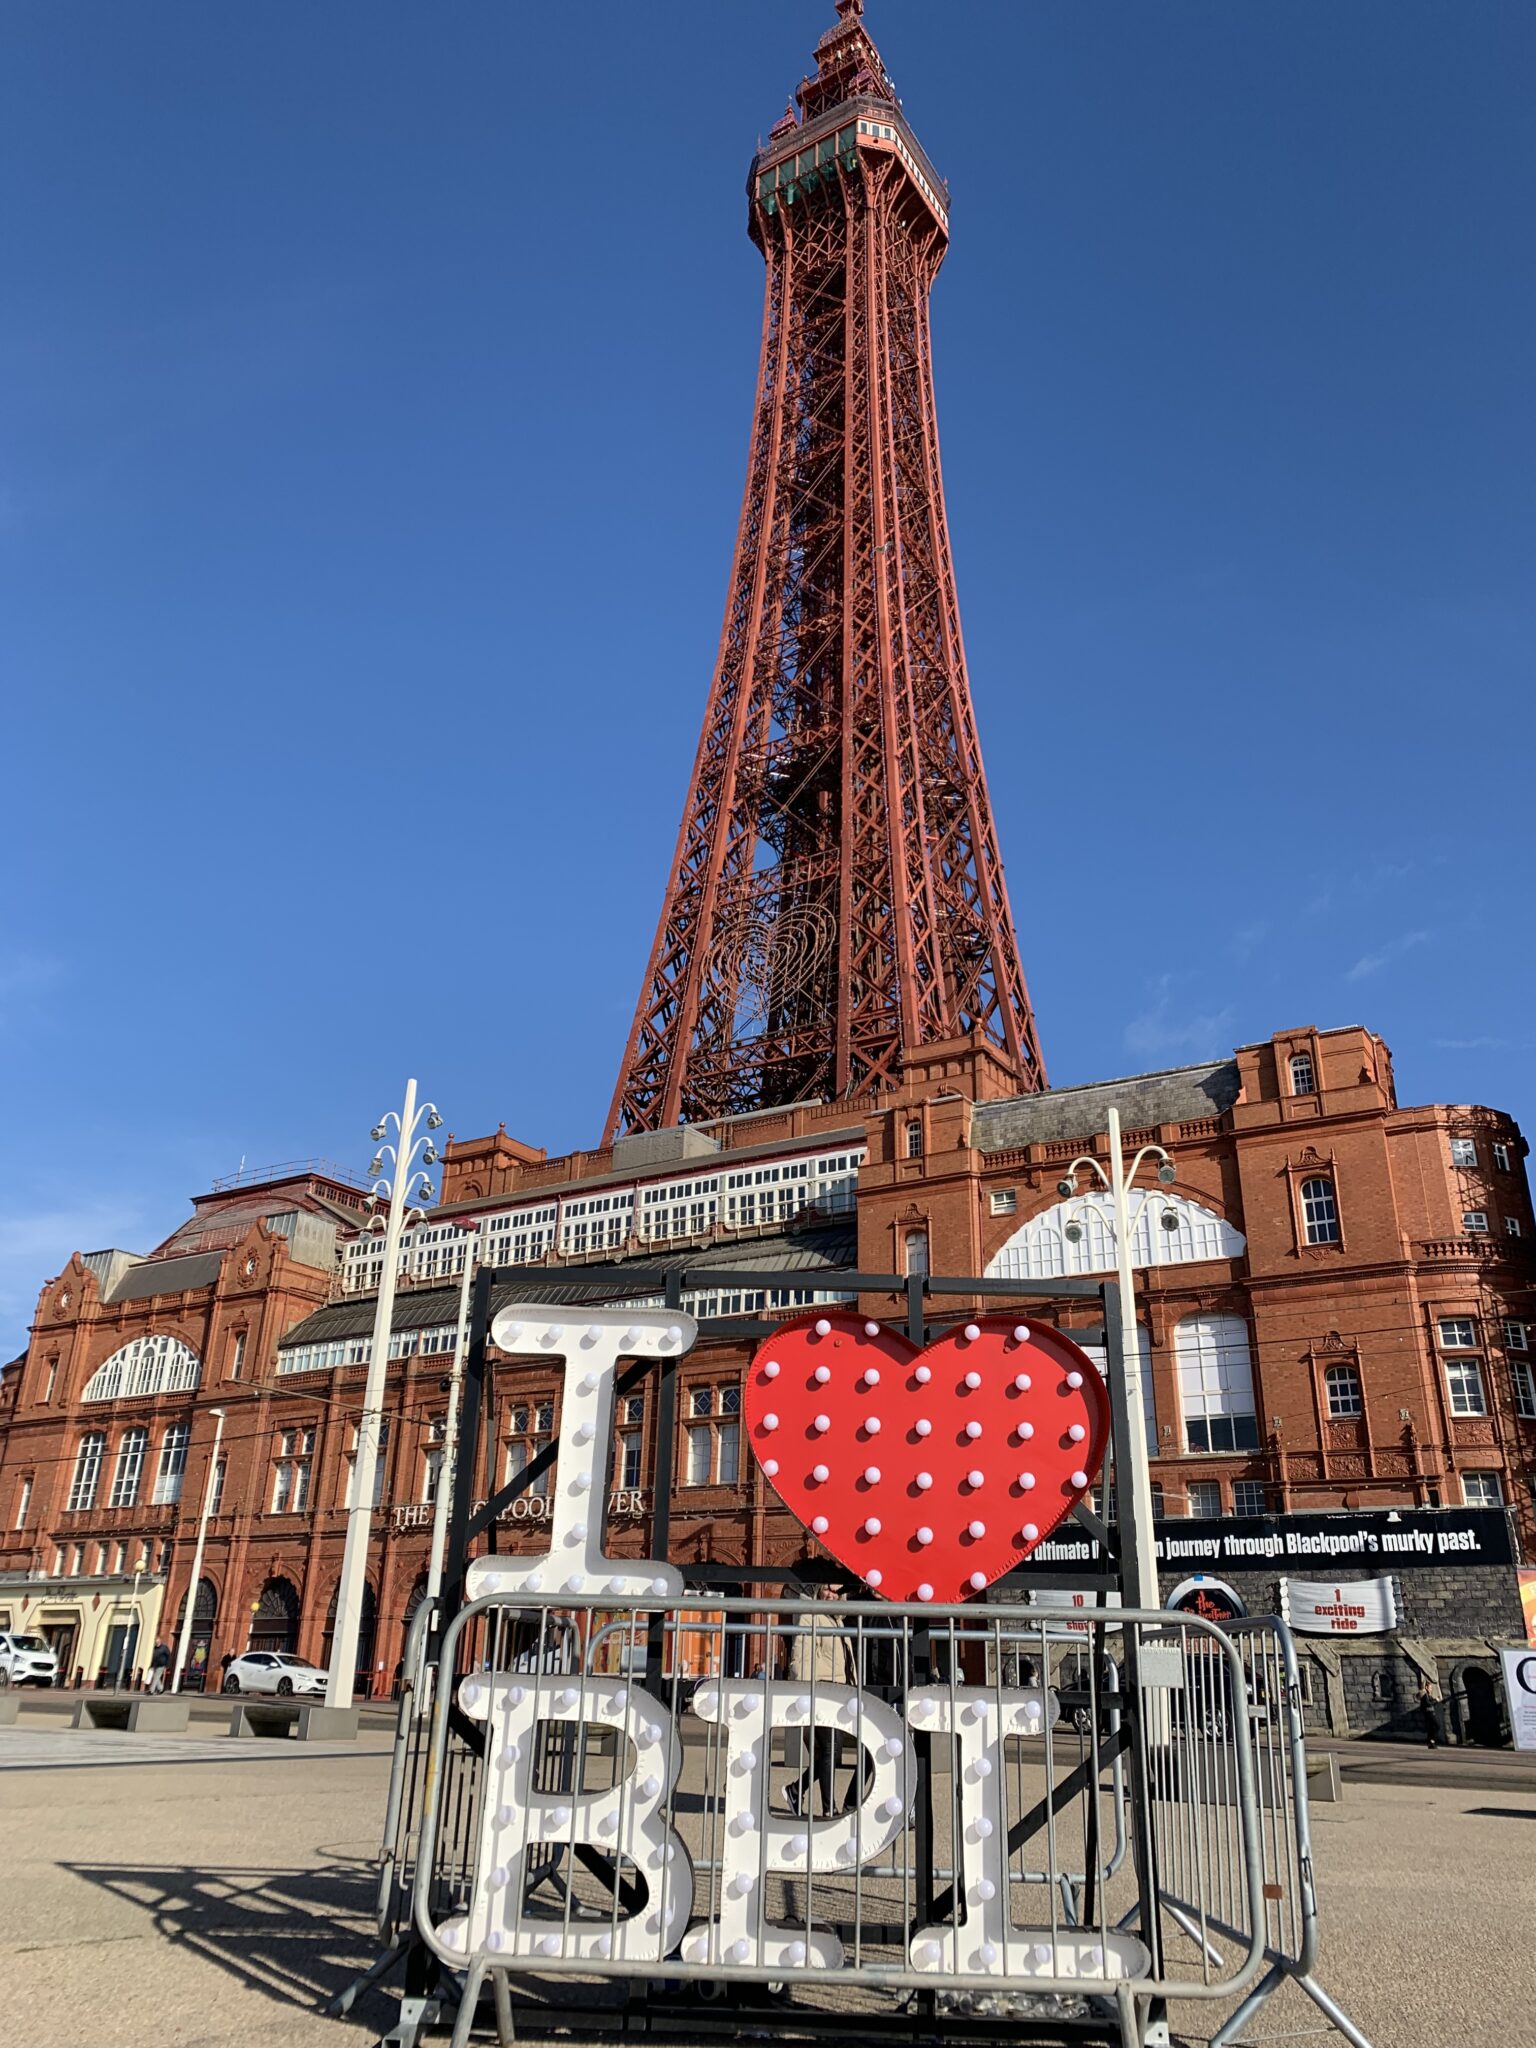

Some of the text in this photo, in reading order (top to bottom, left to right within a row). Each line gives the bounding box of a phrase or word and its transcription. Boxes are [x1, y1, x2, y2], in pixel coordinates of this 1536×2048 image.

[465, 1303, 699, 1607] I
[393, 1505, 430, 1526] THE
[1034, 1540, 1090, 1561] ultimate
[1166, 1536, 1221, 1560] journey
[1224, 1534, 1284, 1557] through
[1286, 1530, 1379, 1556] Blackpool's
[1382, 1529, 1434, 1553] murky
[1439, 1529, 1481, 1553] past.
[1072, 1594, 1085, 1608] 10
[1334, 1588, 1342, 1602] 1
[1314, 1604, 1365, 1618] exciting
[1331, 1618, 1358, 1630] ride
[434, 1672, 1151, 1979] BPL
